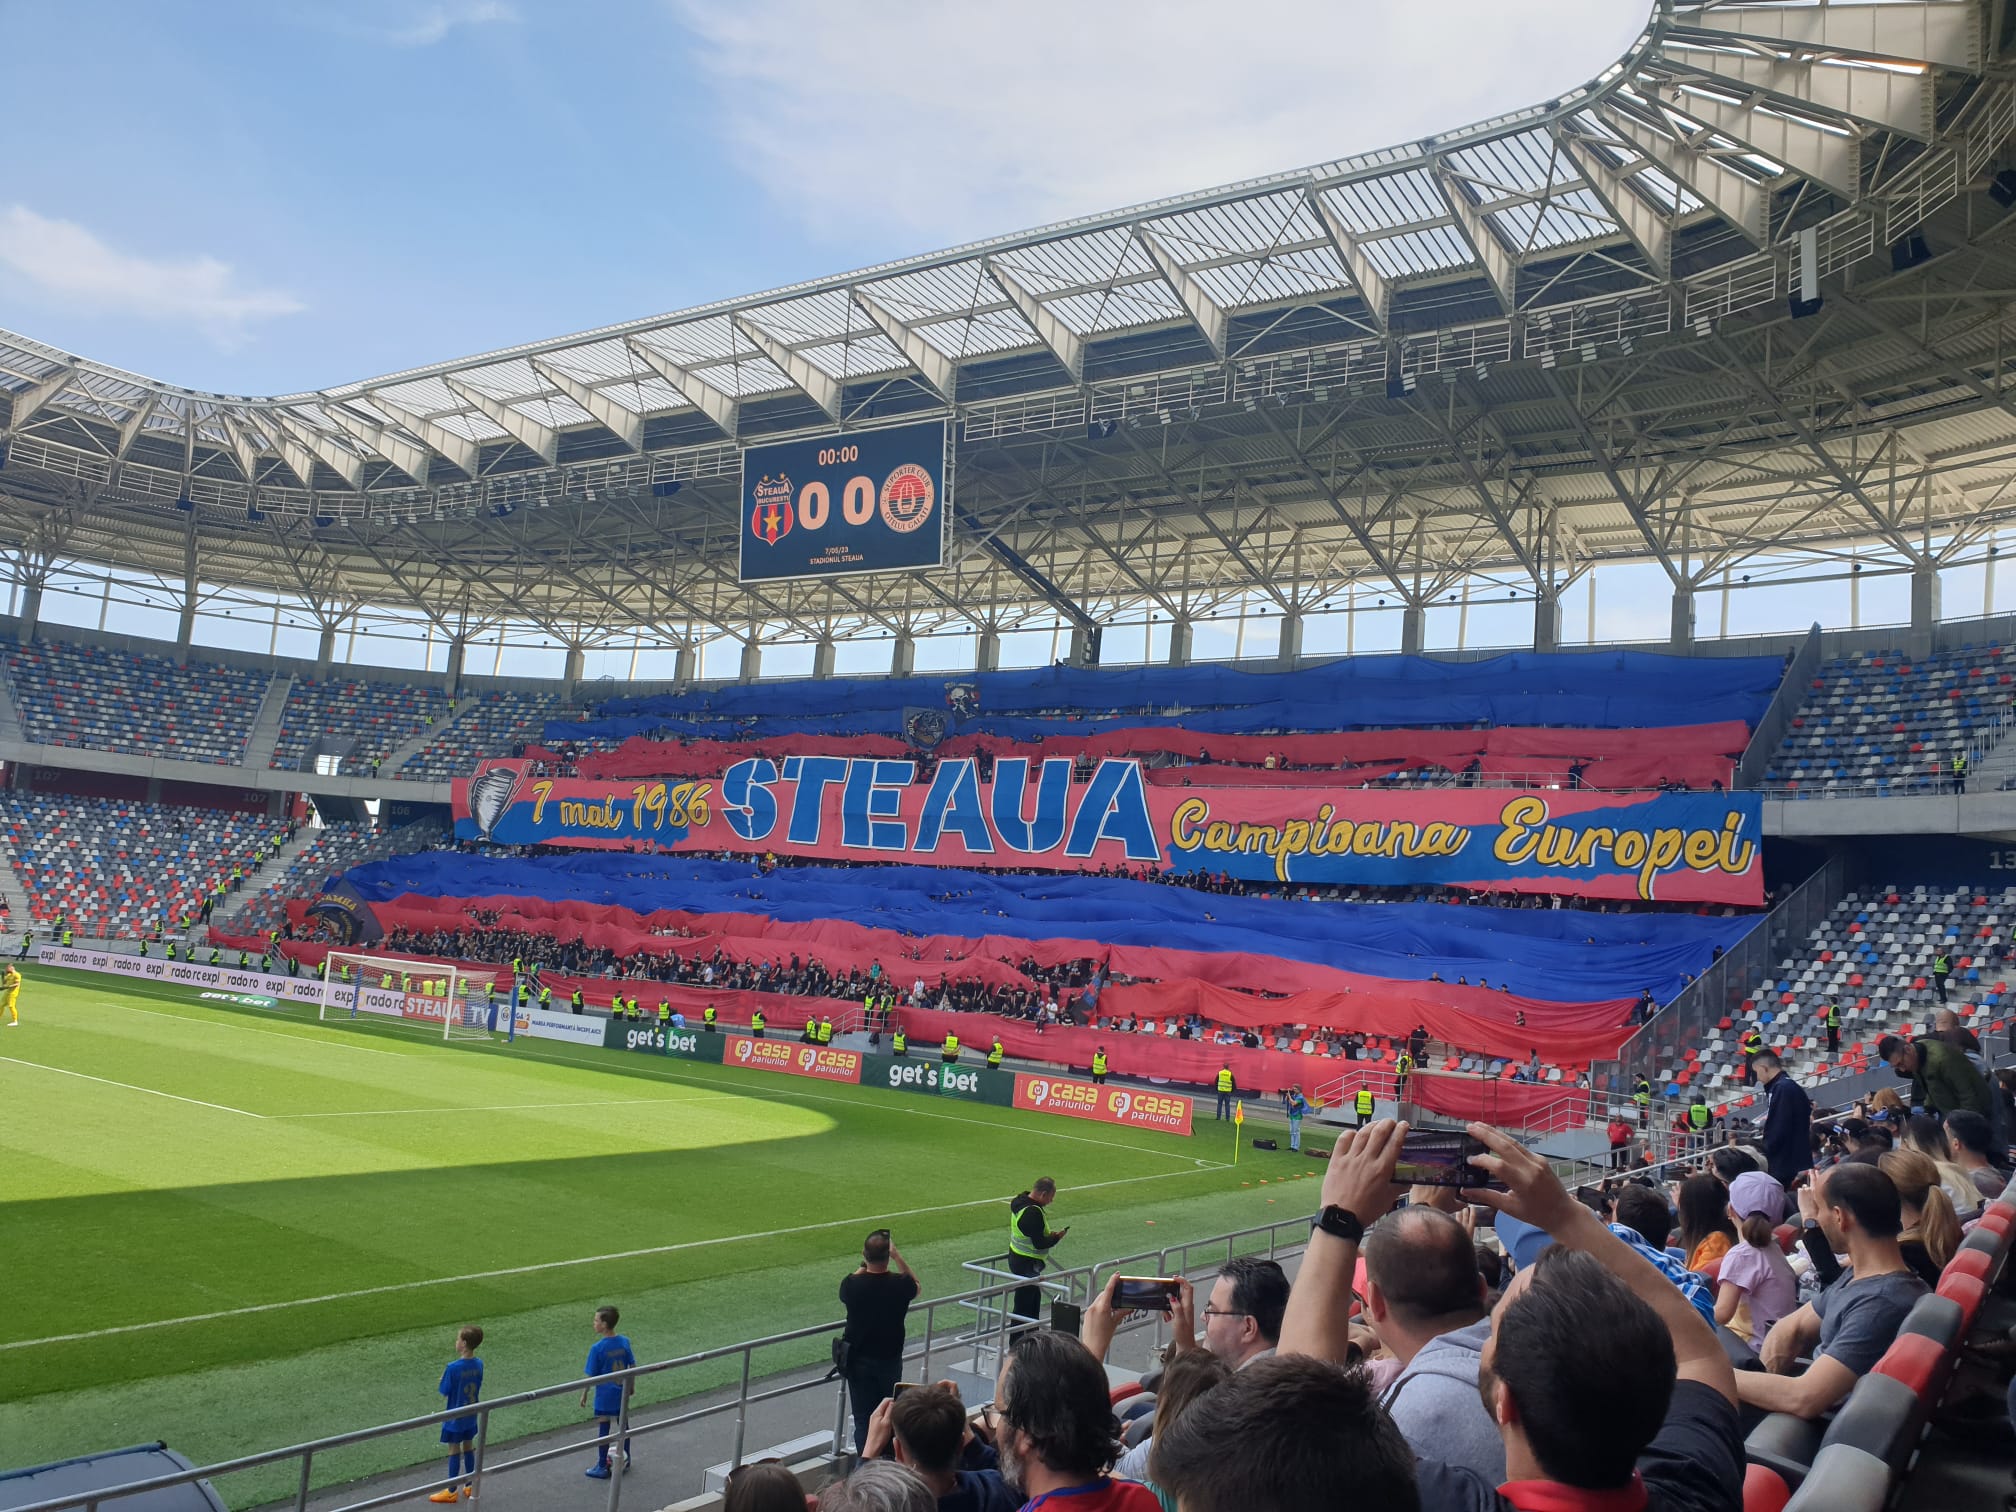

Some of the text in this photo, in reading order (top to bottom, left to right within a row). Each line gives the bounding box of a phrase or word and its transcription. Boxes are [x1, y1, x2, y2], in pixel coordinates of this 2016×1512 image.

[818, 445, 858, 466] 00:00
[916, 469, 931, 488] CLUB
[757, 482, 790, 497] STEAUA
[798, 475, 876, 530] 0 0
[810, 553, 864, 565] STADIONUL STEAUA
[242, 792, 267, 803] 107
[531, 755, 1756, 900] 7 mai 1986 STEAUA Campioana Europei
[238, 997, 271, 1007] bet
[471, 1006, 491, 1024] TV
[627, 1027, 697, 1053] get's bet
[753, 1042, 792, 1060] casa
[817, 1051, 857, 1069] casa
[751, 1055, 789, 1067] pariurilor
[815, 1064, 854, 1077] pariurilor
[889, 1063, 978, 1092] get's bet
[1050, 1082, 1099, 1104] casa
[1048, 1098, 1096, 1113] pariurilor
[1133, 1095, 1185, 1117] casa
[1131, 1111, 1182, 1126] pariurilor
